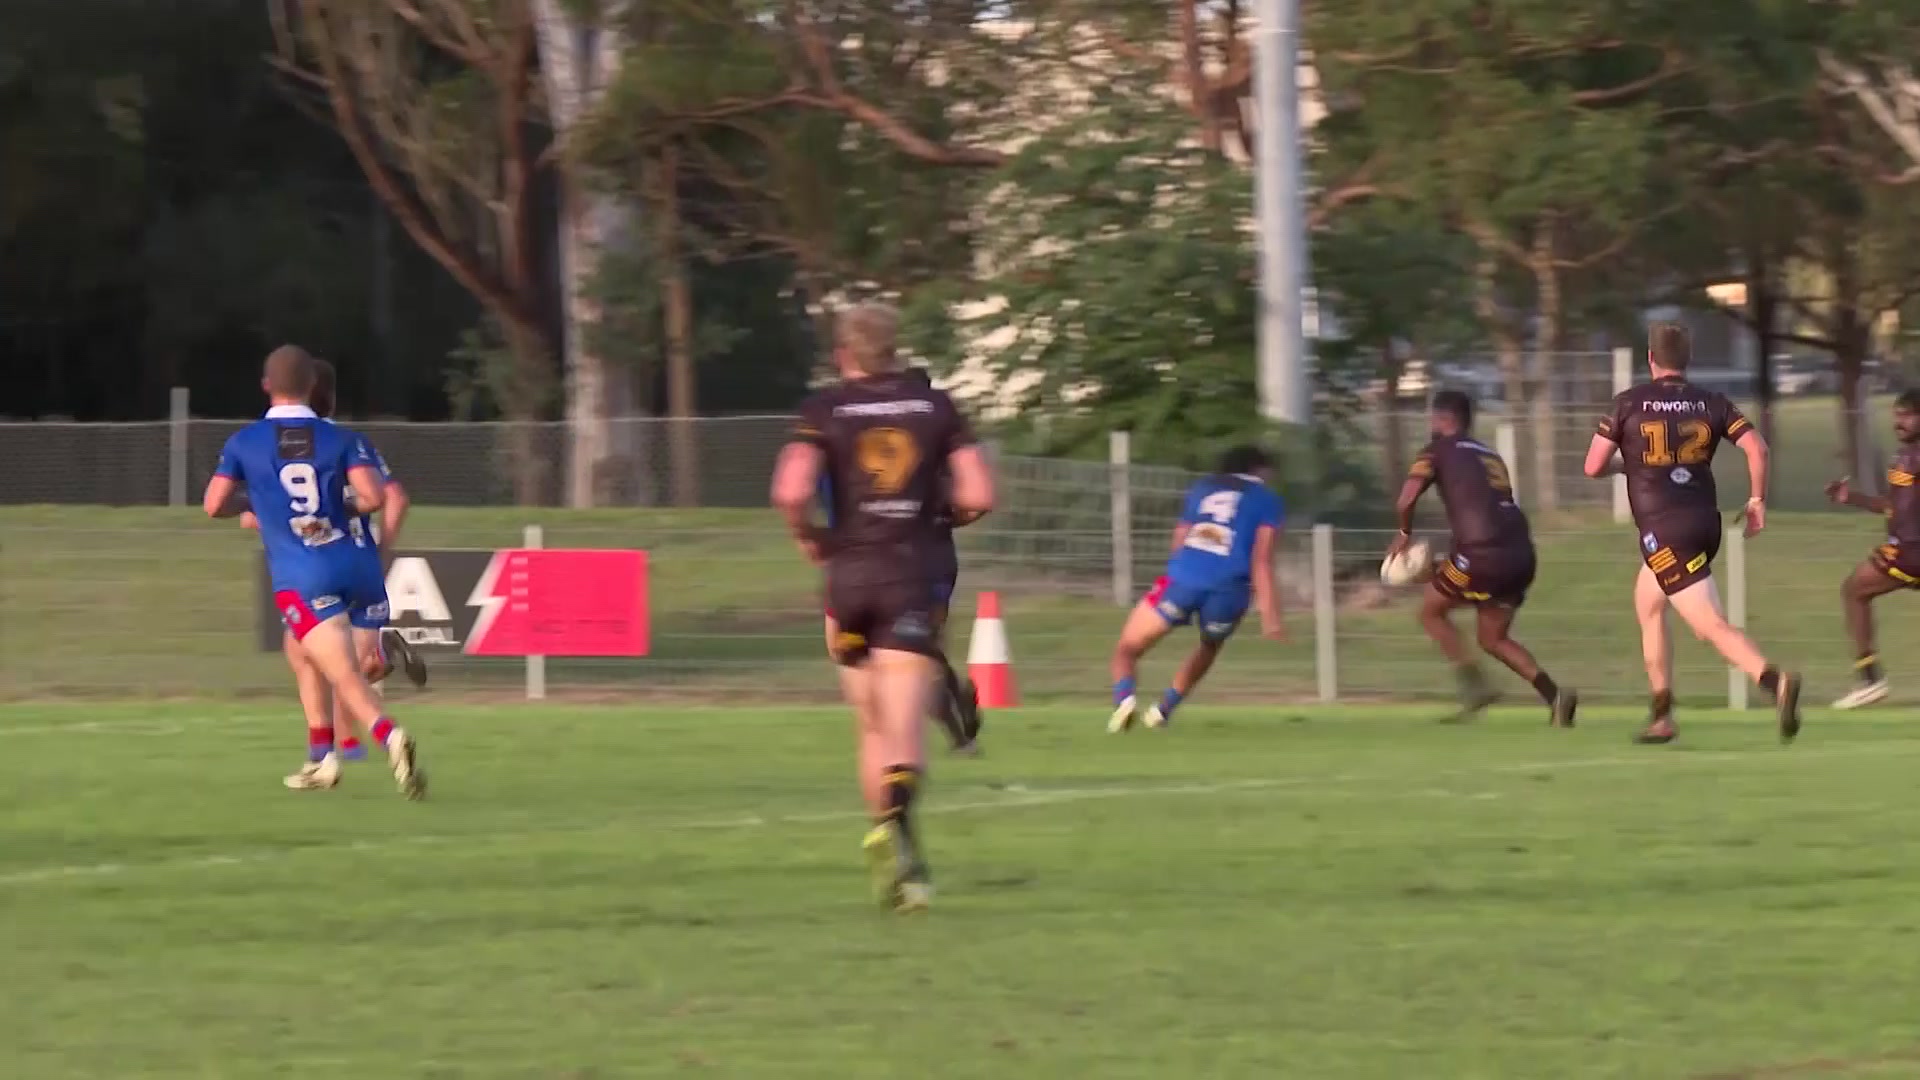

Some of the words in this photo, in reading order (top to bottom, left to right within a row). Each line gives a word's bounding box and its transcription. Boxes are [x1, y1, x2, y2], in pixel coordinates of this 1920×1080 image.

[858, 427, 920, 493] 9
[1640, 420, 1712, 467] 12
[279, 463, 321, 515] 9
[1197, 490, 1244, 524] 4
